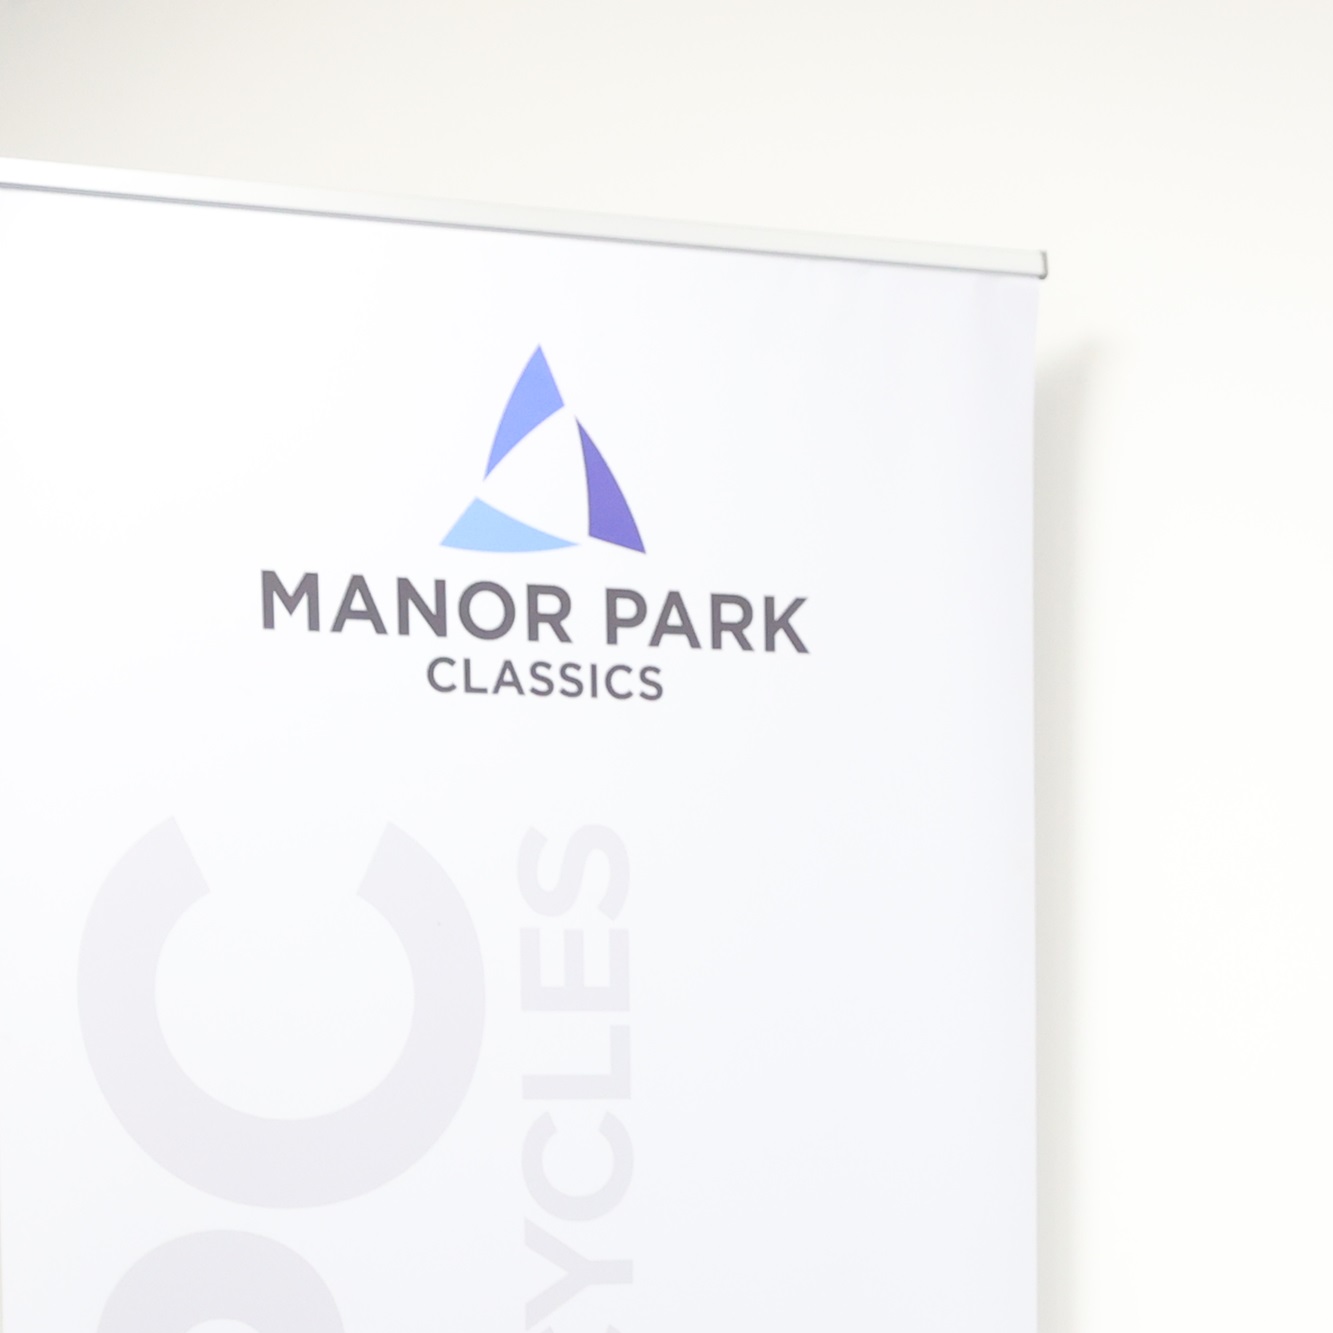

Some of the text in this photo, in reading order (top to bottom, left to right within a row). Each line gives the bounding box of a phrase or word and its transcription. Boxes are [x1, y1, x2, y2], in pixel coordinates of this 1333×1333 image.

[261, 570, 809, 654] MANOR PARK
[426, 656, 664, 701] CLASSICS
